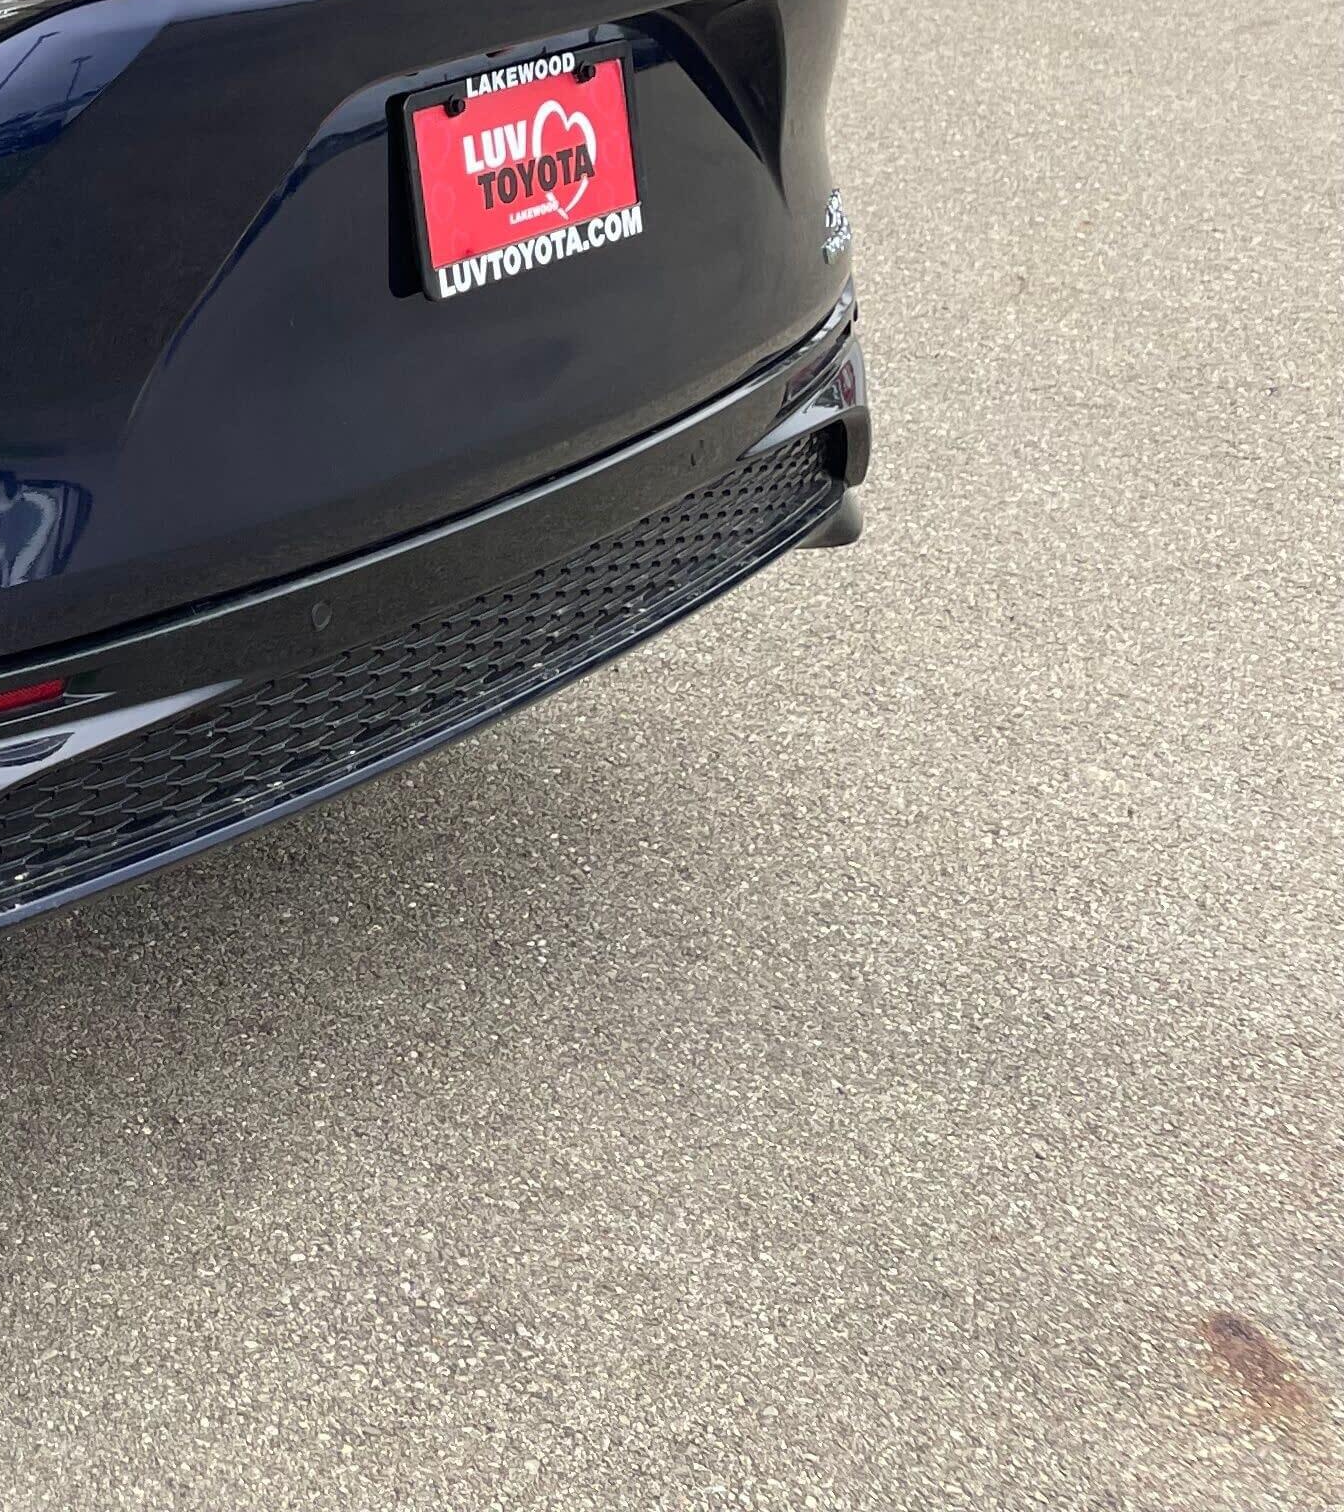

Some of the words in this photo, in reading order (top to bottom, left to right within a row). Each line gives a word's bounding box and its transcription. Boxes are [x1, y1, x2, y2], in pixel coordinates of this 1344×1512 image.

[466, 52, 576, 98] LAKEWOOD
[463, 120, 527, 174] LUV
[478, 143, 595, 210] TOYOTA
[438, 205, 643, 299] LUVTOYOTA.COM
